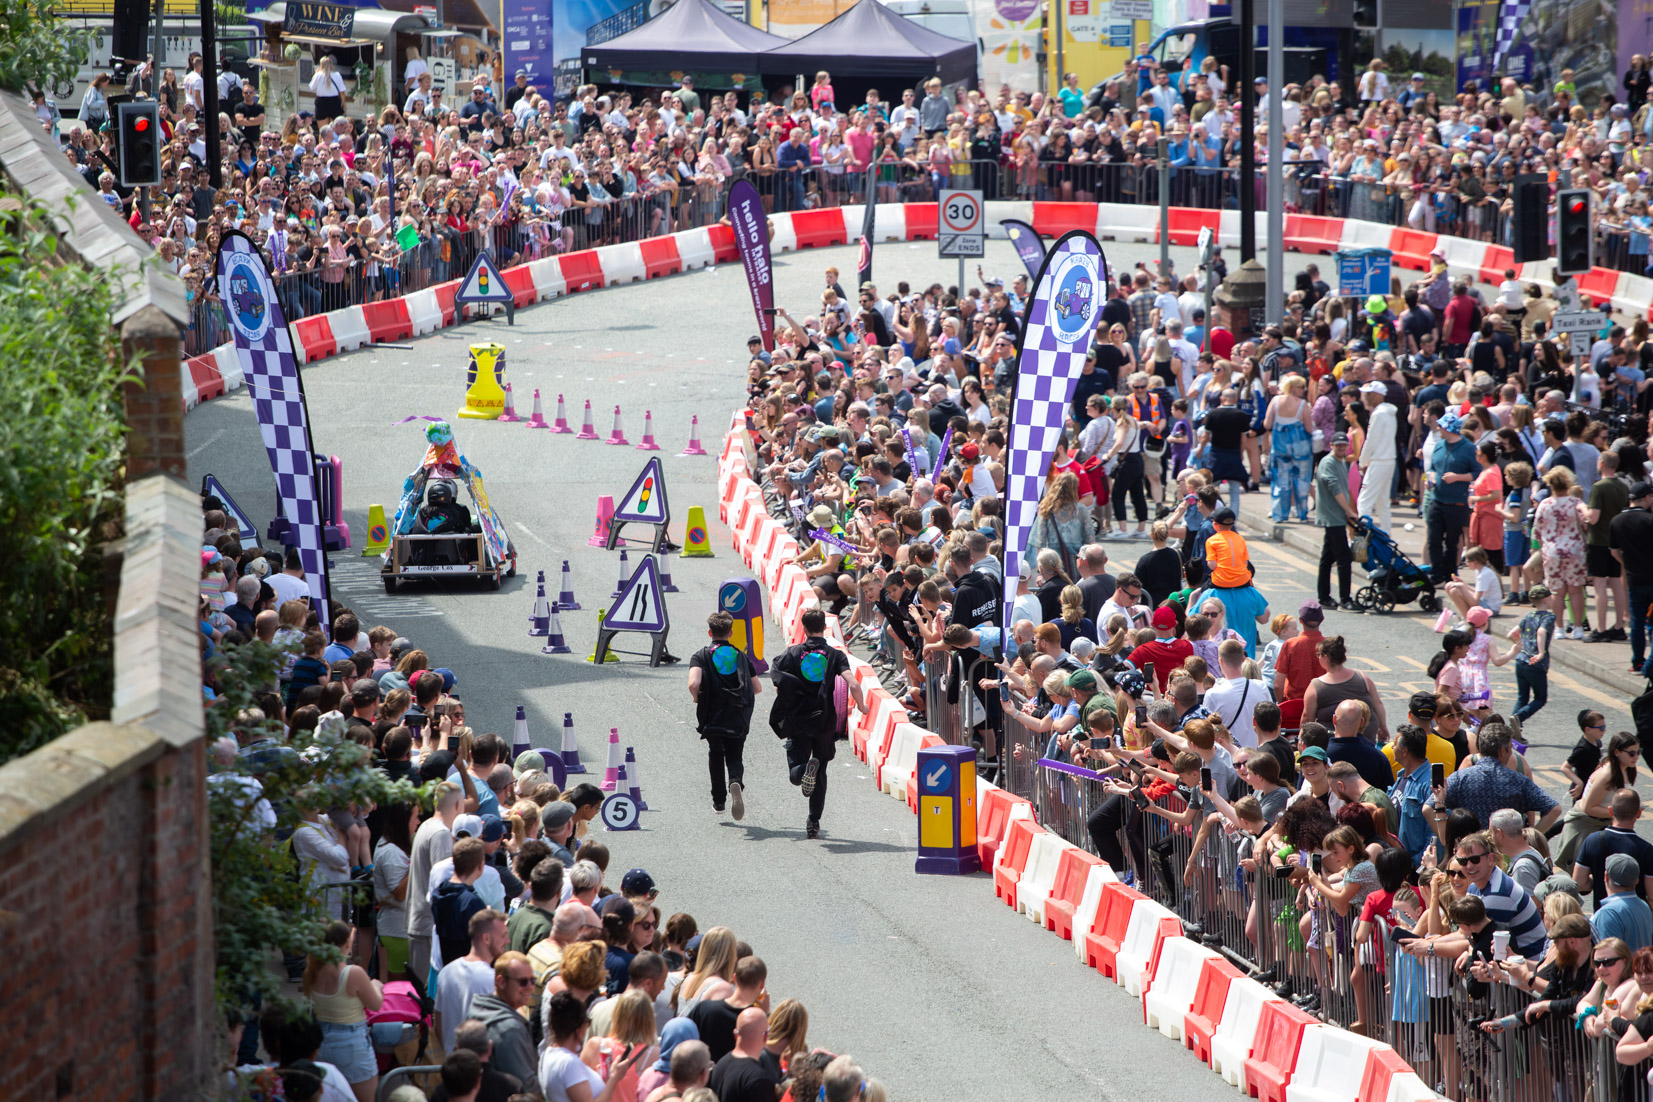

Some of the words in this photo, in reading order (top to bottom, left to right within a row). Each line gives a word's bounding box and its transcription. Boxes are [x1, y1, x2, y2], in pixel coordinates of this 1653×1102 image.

[302, 3, 343, 22] WINE
[948, 204, 975, 220] 30
[741, 199, 759, 243] hello
[753, 244, 770, 285] halo
[958, 244, 980, 252] ENDS
[731, 206, 746, 249] Connecting
[744, 249, 753, 274] teams
[749, 273, 756, 283] in
[753, 288, 762, 309] krazy
[758, 308, 768, 331] world
[1070, 255, 1090, 268] KRAZY
[1556, 319, 1576, 328] Taxi
[1578, 316, 1602, 327] Rank
[1058, 331, 1080, 342] RACES
[612, 801, 629, 822] 5
